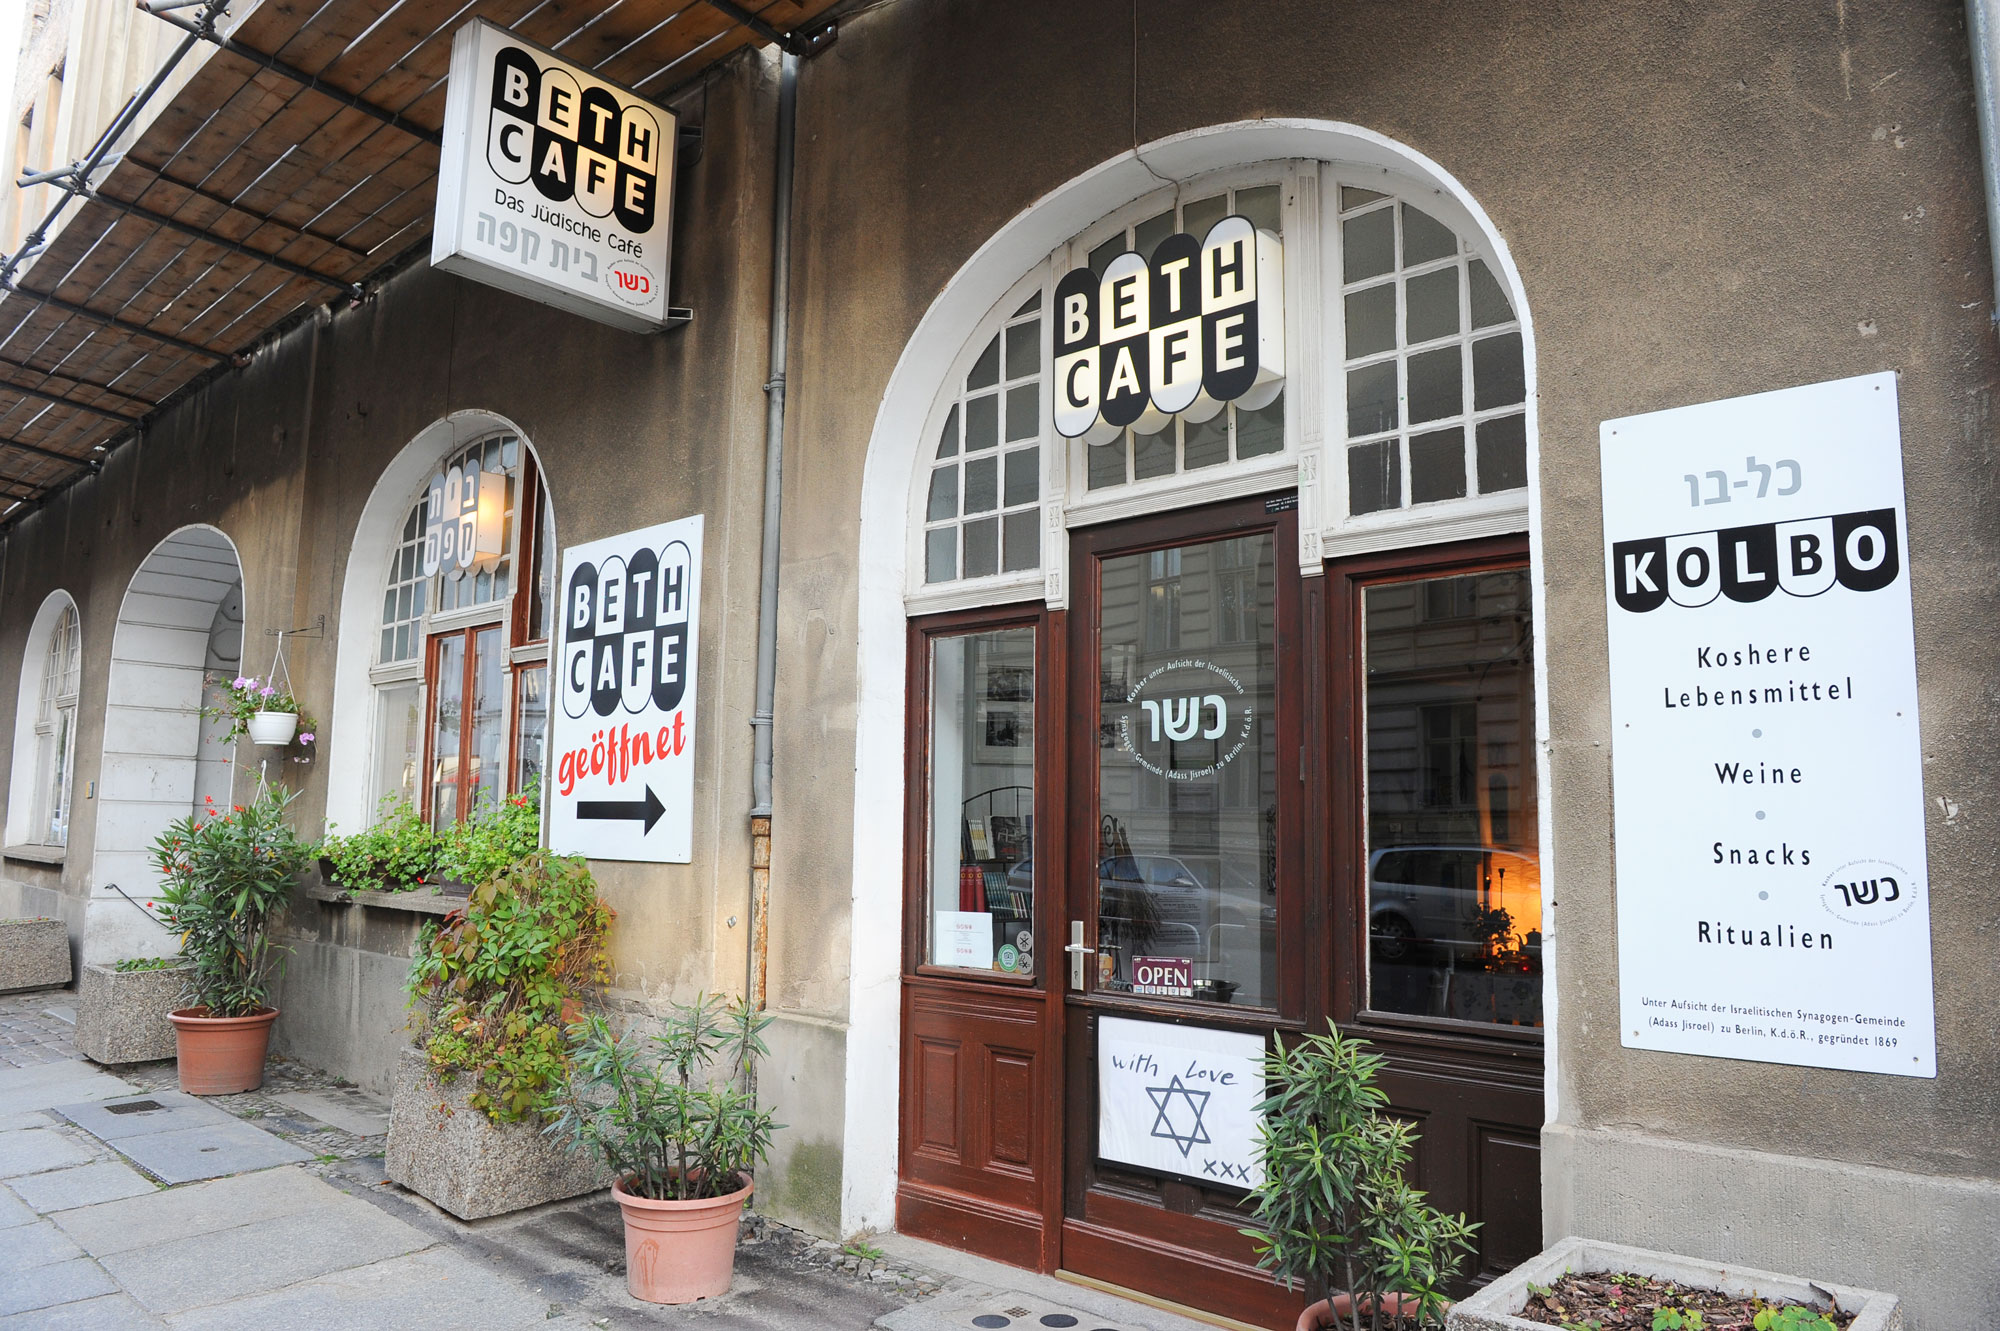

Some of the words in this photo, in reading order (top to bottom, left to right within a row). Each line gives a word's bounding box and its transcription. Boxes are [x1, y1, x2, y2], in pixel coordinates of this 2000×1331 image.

[503, 64, 651, 164] BETH
[499, 123, 647, 215] CAFE
[476, 211, 541, 265] קפה
[494, 188, 525, 213] Das
[530, 203, 601, 243] Jüdische
[607, 233, 643, 258] Café
[549, 238, 599, 283] בית
[614, 270, 650, 293] כשר
[1063, 239, 1245, 345] BETH
[1066, 312, 1245, 408] CAFE
[429, 474, 475, 519] בית
[1683, 455, 1802, 507] כל-בו
[1624, 524, 1887, 594] KOLBO
[572, 564, 684, 629] BETH
[570, 634, 680, 694] CAFE
[1697, 643, 1811, 668] Koshere
[1126, 677, 1147, 703] Kosher
[1148, 666, 1164, 679] unter
[1167, 659, 1193, 670] Aufsicht
[1194, 659, 1206, 668] der
[1207, 661, 1244, 695] Israelitischen
[1664, 676, 1853, 709] Lebensmittel
[1141, 694, 1227, 742] כשר
[558, 710, 687, 797] geöffnet
[1120, 715, 1163, 776] Synagogen-Gemeinde
[1165, 769, 1188, 780] (Adass
[1190, 764, 1215, 781] Jisroel)
[1216, 761, 1225, 770] zu
[1224, 741, 1245, 763] Berlin,
[1713, 762, 1803, 785] Weine
[1712, 842, 1812, 866] Snacks
[1833, 877, 1900, 907] כשר
[1697, 921, 1834, 950] Ritualien
[1137, 966, 1188, 987] OPEN
[1641, 996, 1668, 1008] Unter
[1670, 999, 1707, 1011] Aufsicht
[1711, 1003, 1727, 1013] der
[1730, 1004, 1792, 1018] Israelitischen
[1797, 1009, 1906, 1028] Synagogen-Gemeinde
[1648, 1016, 1678, 1028] (Adass
[1682, 1019, 1715, 1034] Jisroel)
[1720, 1025, 1731, 1033] zu
[1735, 1024, 1766, 1038] Berlin,
[1818, 1034, 1869, 1046] gegründet
[1874, 1036, 1898, 1048] 1869
[1112, 1054, 1159, 1077] with
